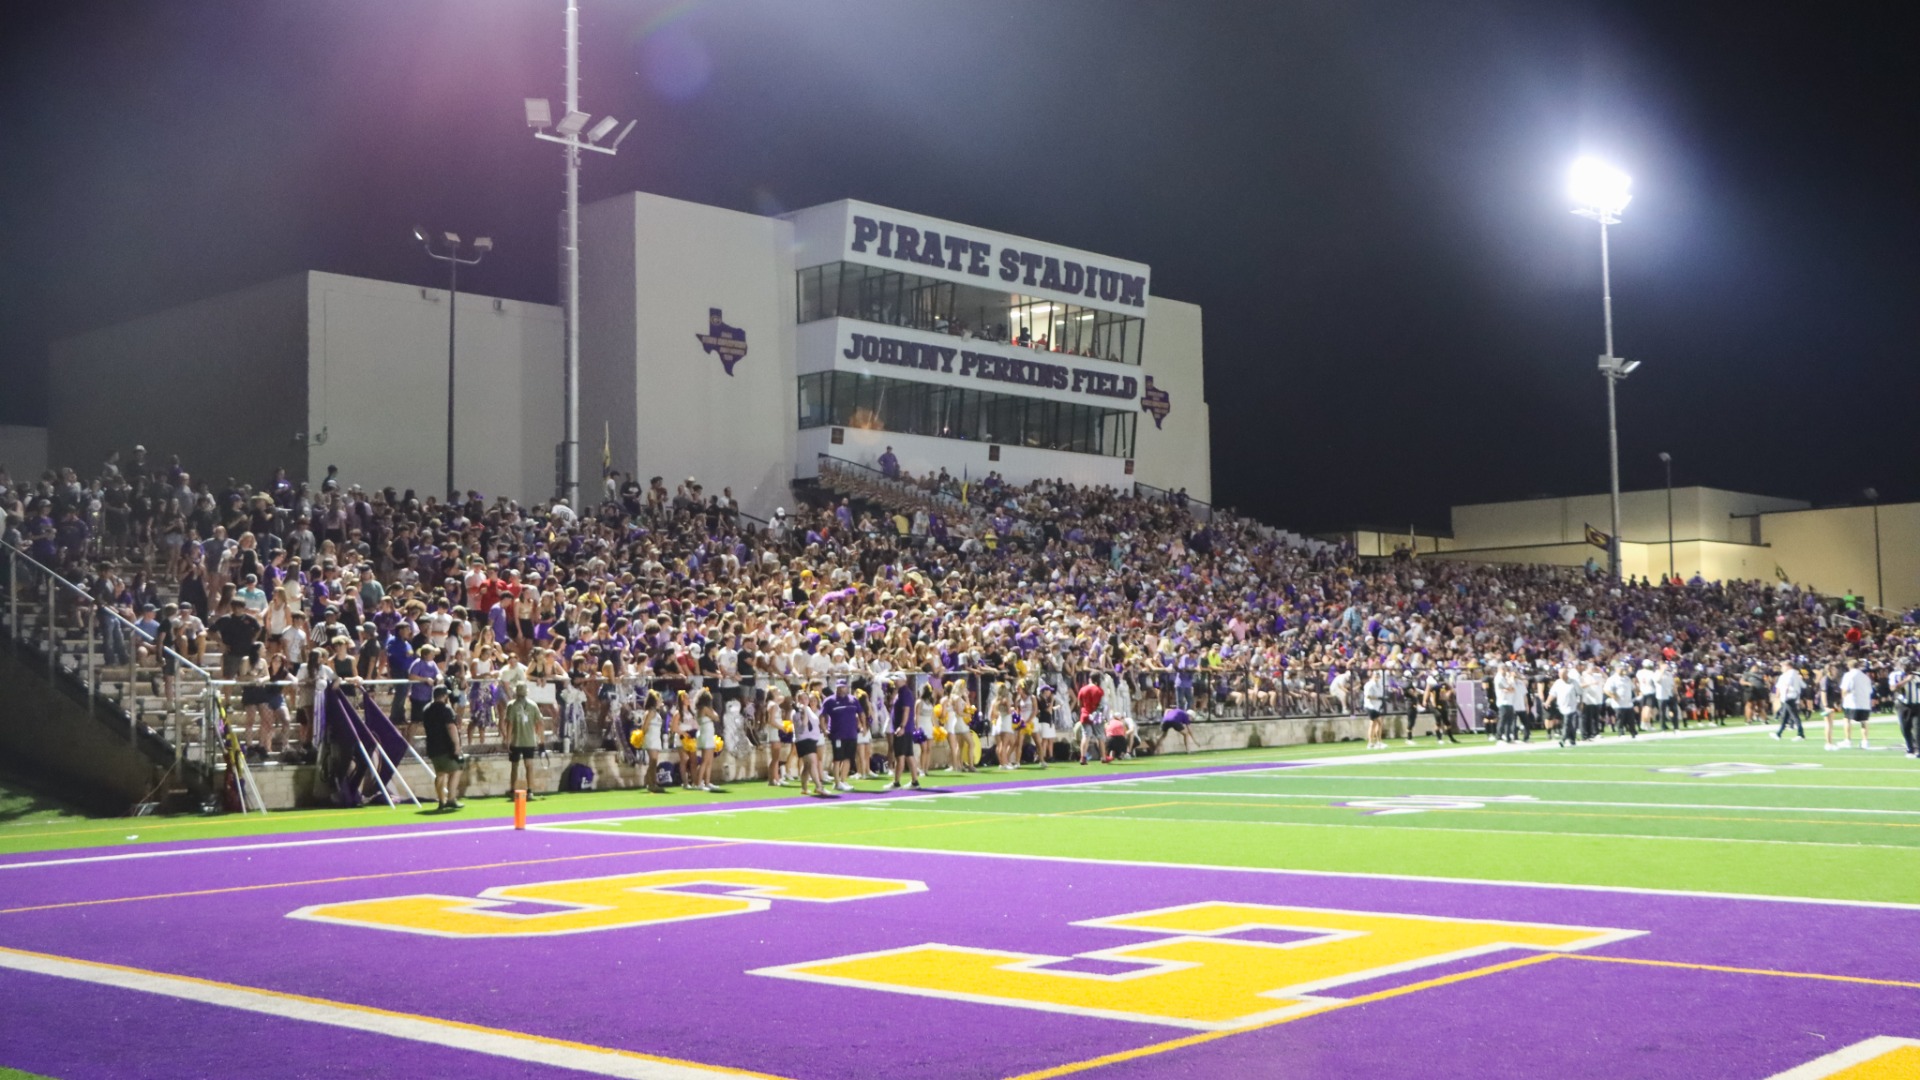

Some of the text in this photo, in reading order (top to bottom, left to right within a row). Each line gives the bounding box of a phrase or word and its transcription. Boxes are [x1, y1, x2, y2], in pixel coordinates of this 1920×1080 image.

[852, 216, 1146, 307] PIRATE STADIUM
[844, 333, 1138, 400] JOHNNY PERKINS FIELD
